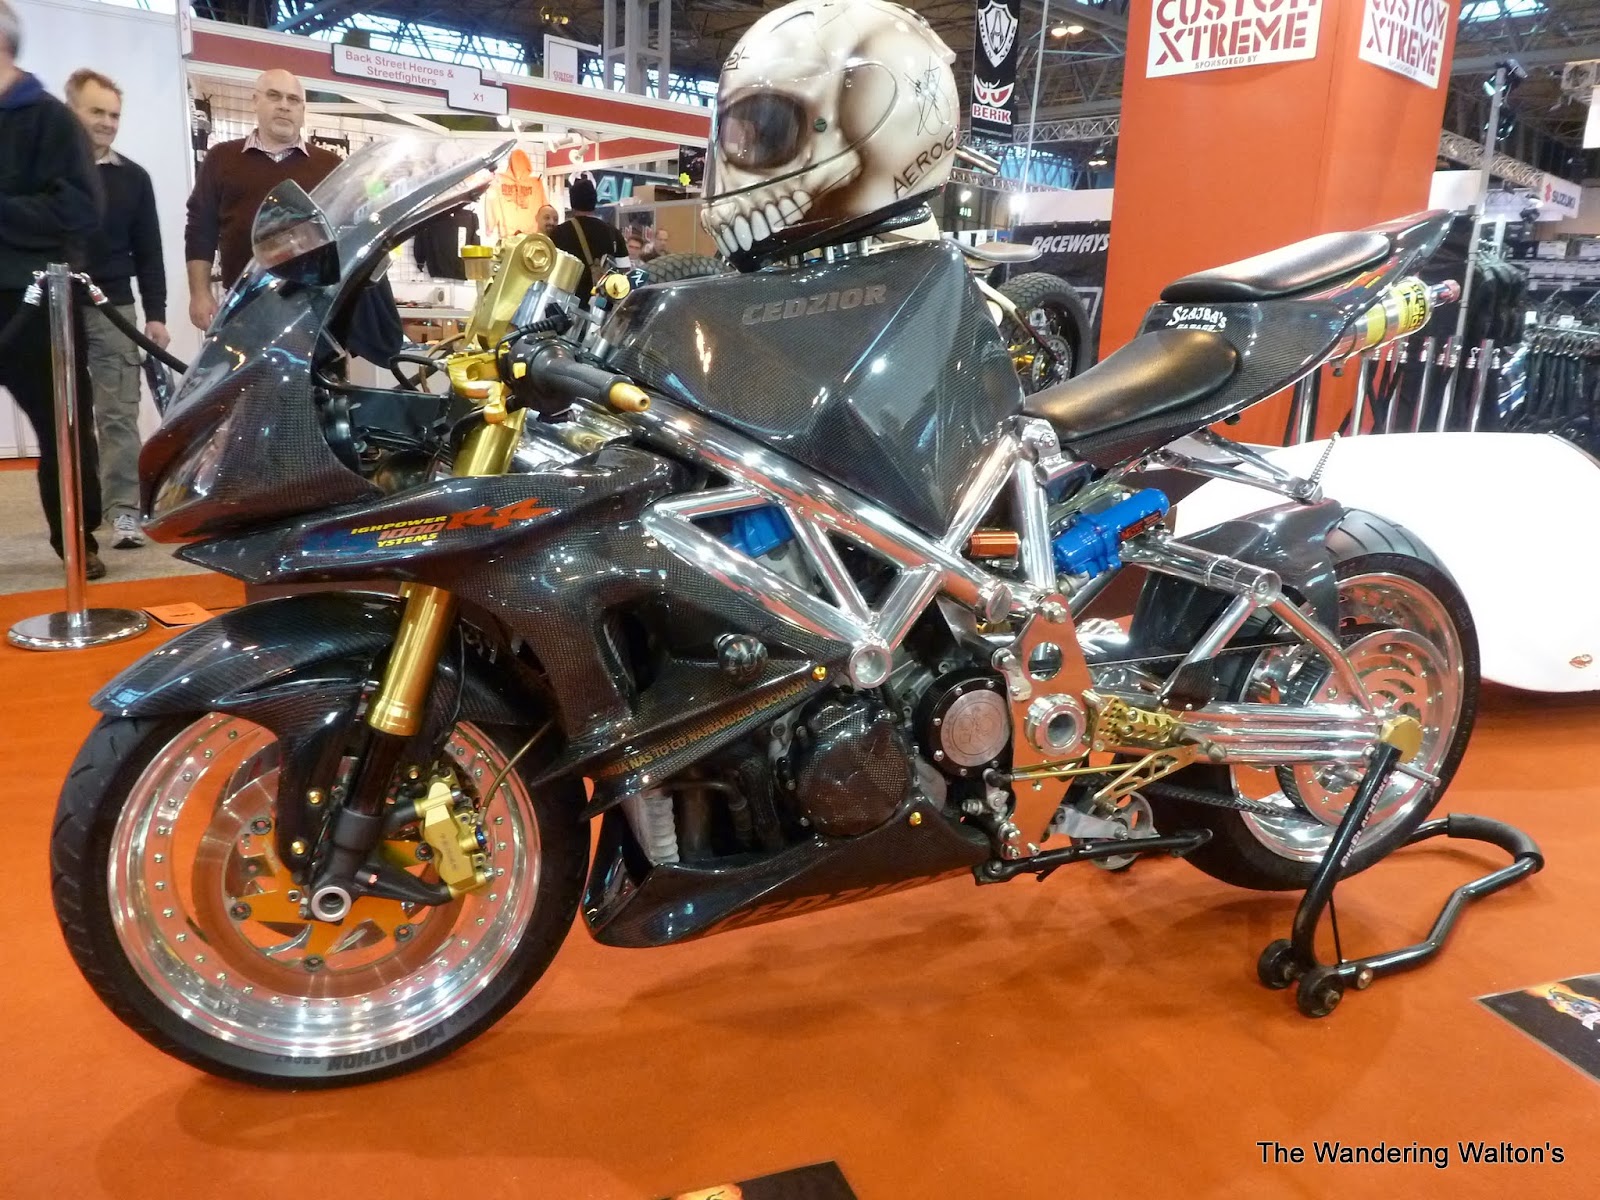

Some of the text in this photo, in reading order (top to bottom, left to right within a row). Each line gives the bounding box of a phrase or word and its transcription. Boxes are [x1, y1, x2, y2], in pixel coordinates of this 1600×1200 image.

[1155, 11, 1308, 66] XTREME
[1366, 12, 1439, 76] XTREME
[345, 51, 454, 78] Back Street Heroes &
[1194, 55, 1257, 69] SPONSORED BY
[367, 66, 437, 86] Streetfighters
[473, 92, 484, 101] X1
[1032, 233, 1110, 253] RACEWAYS
[742, 283, 887, 326] CEDZIOR
[350, 515, 448, 536] IGHPOWER
[377, 522, 446, 540] 1000
[376, 532, 439, 548] YSTEMS
[628, 755, 653, 769] NAS
[655, 745, 669, 758] TO
[670, 737, 687, 750] CO
